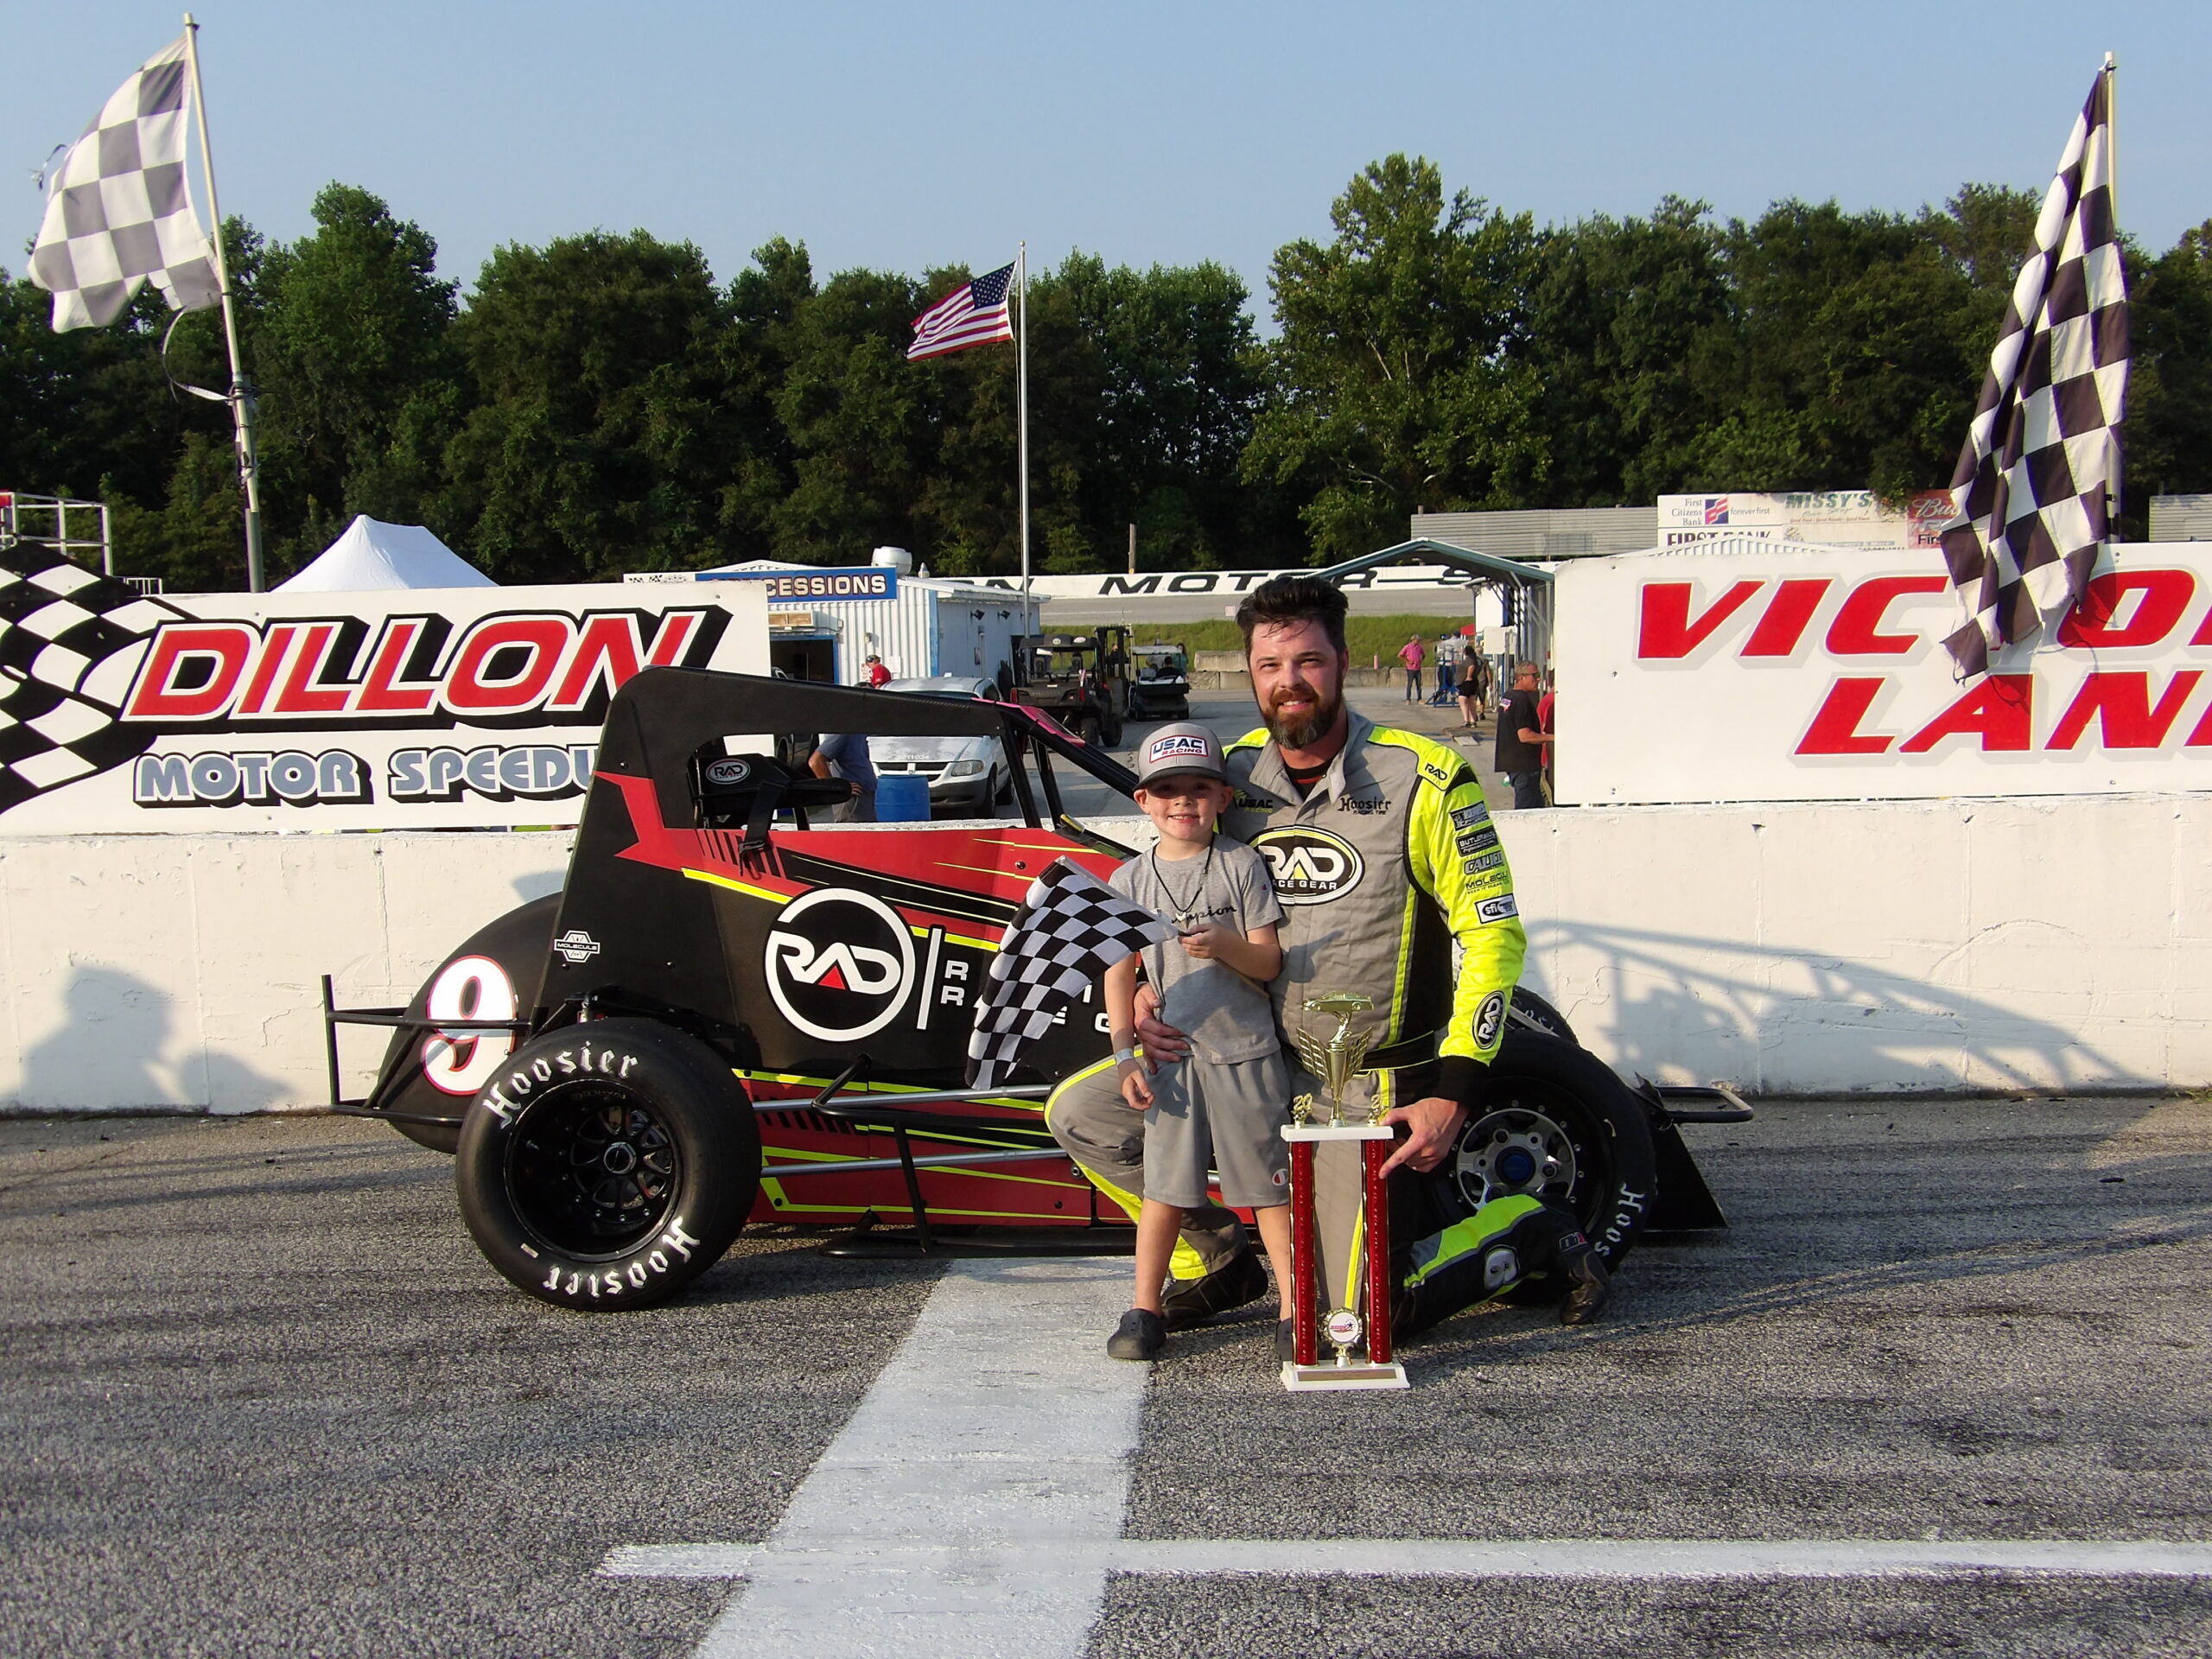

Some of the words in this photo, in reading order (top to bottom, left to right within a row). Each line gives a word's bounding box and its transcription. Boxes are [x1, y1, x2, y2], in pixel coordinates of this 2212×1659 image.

[1671, 508, 1702, 517] Citizens
[1756, 506, 1770, 515] first
[1682, 518, 1702, 526] Bank
[766, 575, 887, 597] CESSIONS
[1637, 569, 2212, 658] VICO
[124, 608, 710, 722] DILLON
[1795, 671, 2212, 754] LAN
[1154, 738, 1202, 754] USAC
[1161, 747, 1202, 756] RACING
[137, 748, 366, 804] MOTOR
[714, 765, 743, 776] RAD
[1425, 763, 1447, 780] RAD
[1237, 798, 1274, 809] USAC
[1338, 796, 1392, 812] Hoosier
[1258, 845, 1345, 881] RAD
[1299, 880, 1338, 890] GEAR
[1466, 870, 1508, 889] MOLECU
[769, 930, 901, 995] RAD
[422, 955, 516, 1096] 9
[1478, 998, 1502, 1039] RAD
[482, 1039, 639, 1130] Hoosier
[1593, 1181, 1645, 1257] Hoos
[542, 1215, 701, 1298] Hoosier
